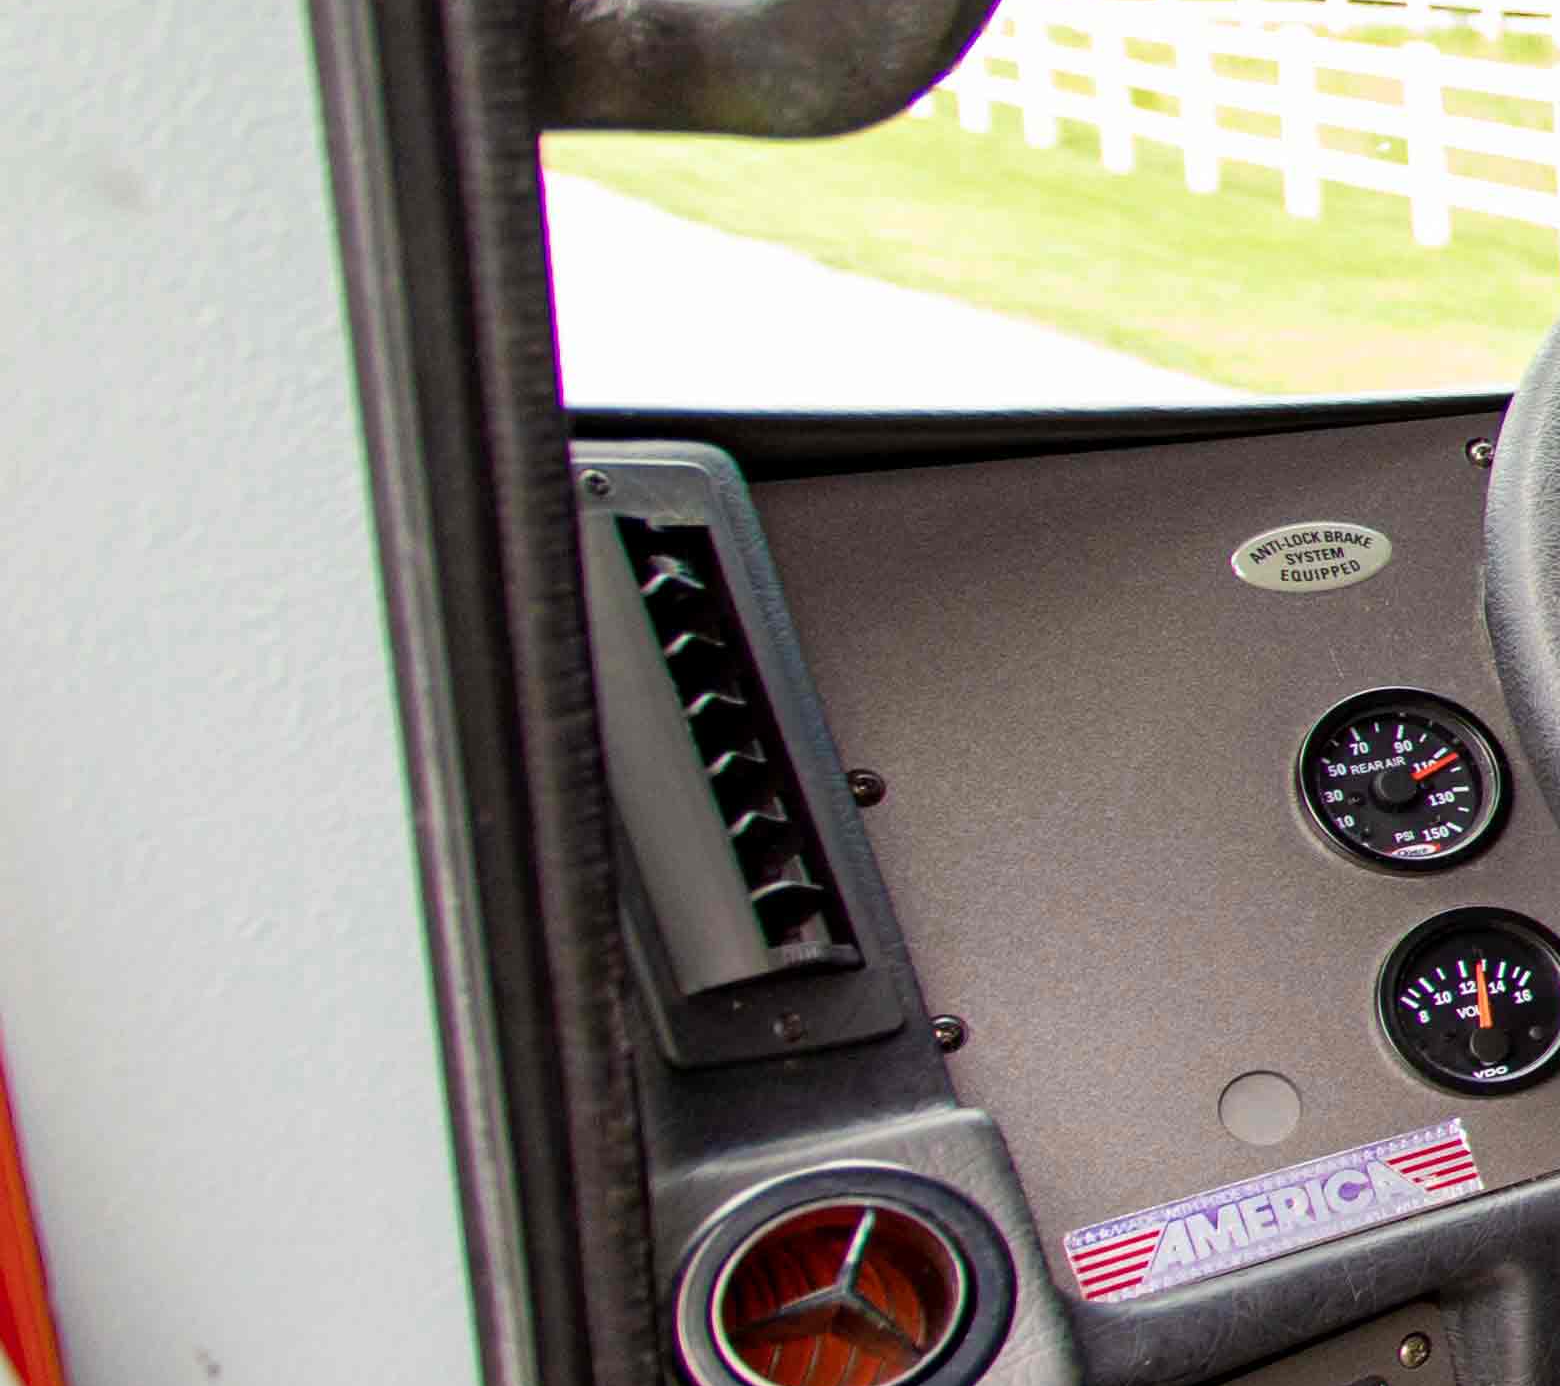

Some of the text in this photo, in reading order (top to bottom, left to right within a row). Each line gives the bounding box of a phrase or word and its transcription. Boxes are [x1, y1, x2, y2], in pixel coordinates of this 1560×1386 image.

[1249, 531, 1374, 564] ANTI-LOCK BRAKE
[1285, 547, 1345, 565] SYSTEM
[1280, 559, 1361, 582] EQUIPPED
[1349, 742, 1369, 756] 70
[1394, 741, 1413, 754] 90
[1327, 764, 1347, 778] 50
[1350, 756, 1406, 775] REAR AIR
[1324, 790, 1344, 803] 30
[1427, 791, 1455, 807] 130
[1336, 816, 1355, 829] 10
[1394, 830, 1415, 843] PSI
[1422, 828, 1449, 841] 150
[1459, 981, 1477, 995] 12
[1488, 980, 1506, 994] 14
[1433, 991, 1452, 1005] 10
[1513, 989, 1533, 1004] 16
[1418, 1010, 1430, 1023] 8
[1472, 1065, 1508, 1079] VDO
[1146, 1158, 1426, 1277] AMERICA
